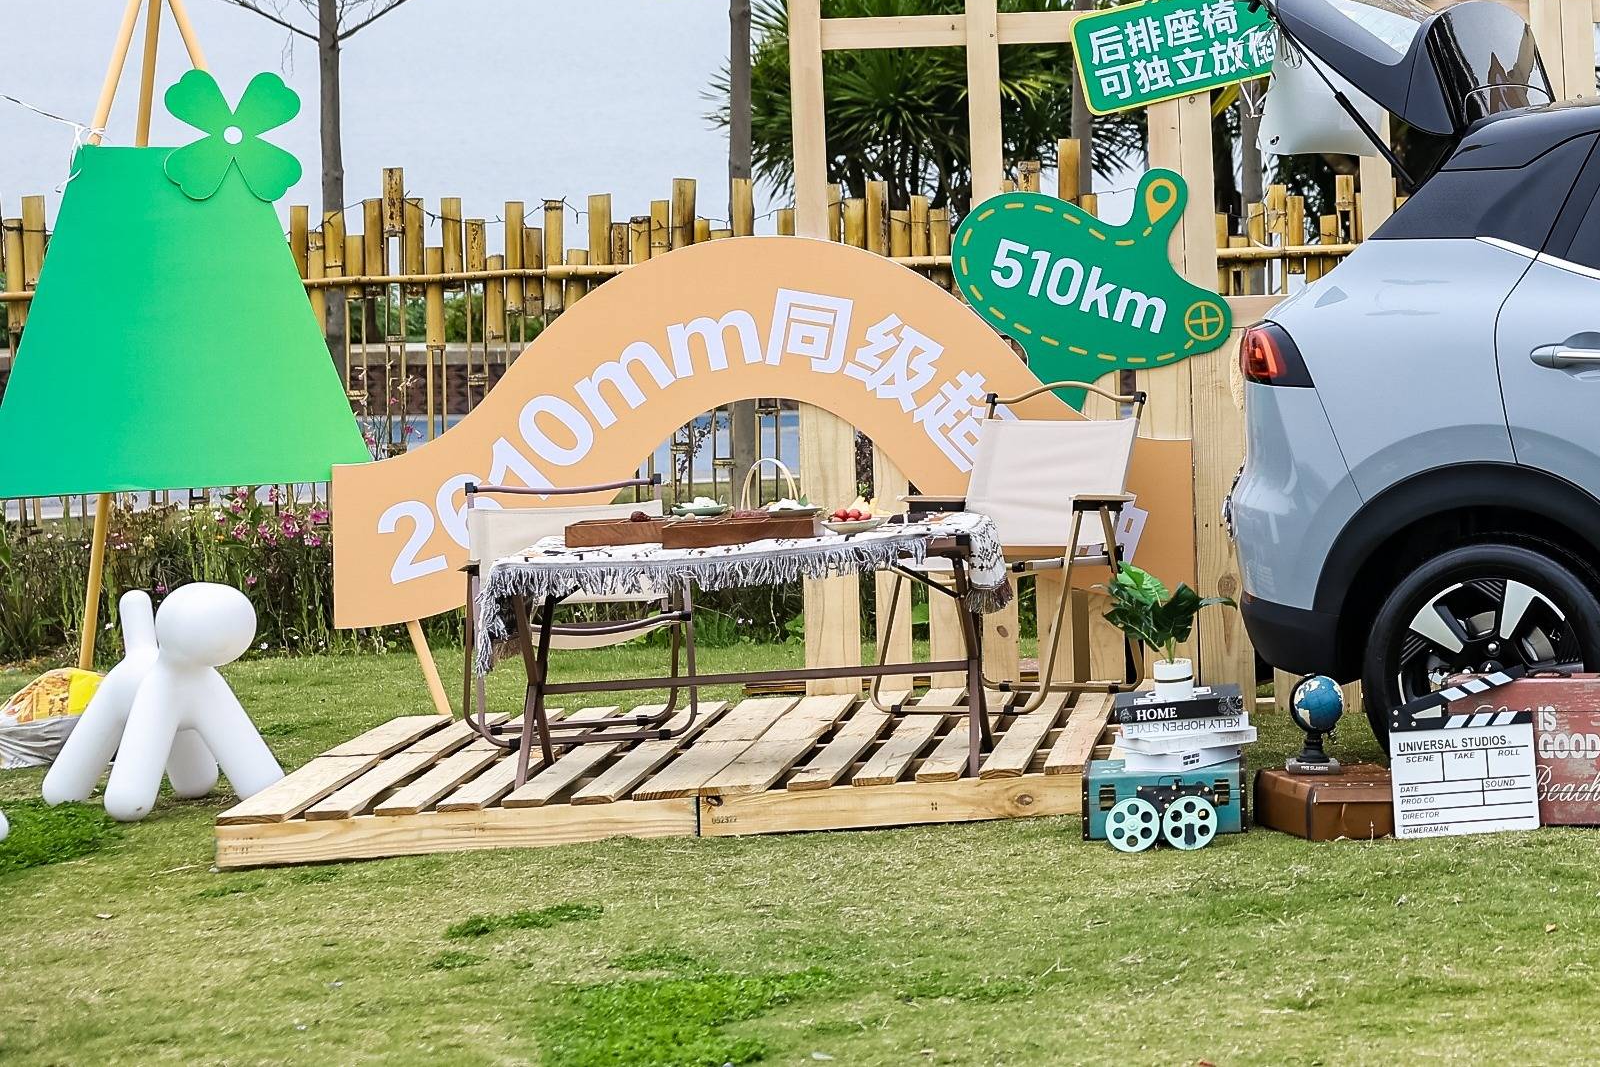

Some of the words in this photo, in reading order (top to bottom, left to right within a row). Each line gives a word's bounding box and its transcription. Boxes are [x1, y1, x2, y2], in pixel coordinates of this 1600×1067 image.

[1089, 0, 1238, 66] 后排座椅
[990, 238, 1167, 334] 510km
[377, 287, 1148, 585] 2610mm同级超
[1136, 707, 1178, 721] HOME
[1538, 705, 1557, 732] IS
[1127, 722, 1160, 735] STYLE
[1162, 720, 1206, 733] HOPPEN
[1208, 717, 1240, 730] KELLY
[1398, 738, 1458, 752] UNIVERSAL
[1461, 735, 1507, 749] STUDIOS
[1538, 733, 1600, 760] GOOD
[1406, 755, 1434, 763] SCENE
[1454, 752, 1475, 760] TAKE
[1497, 749, 1520, 757] ROLL
[1485, 779, 1516, 789] SOUND
[1402, 811, 1440, 820] DIRECTOR
[1403, 825, 1449, 835] CAMERAMAN
